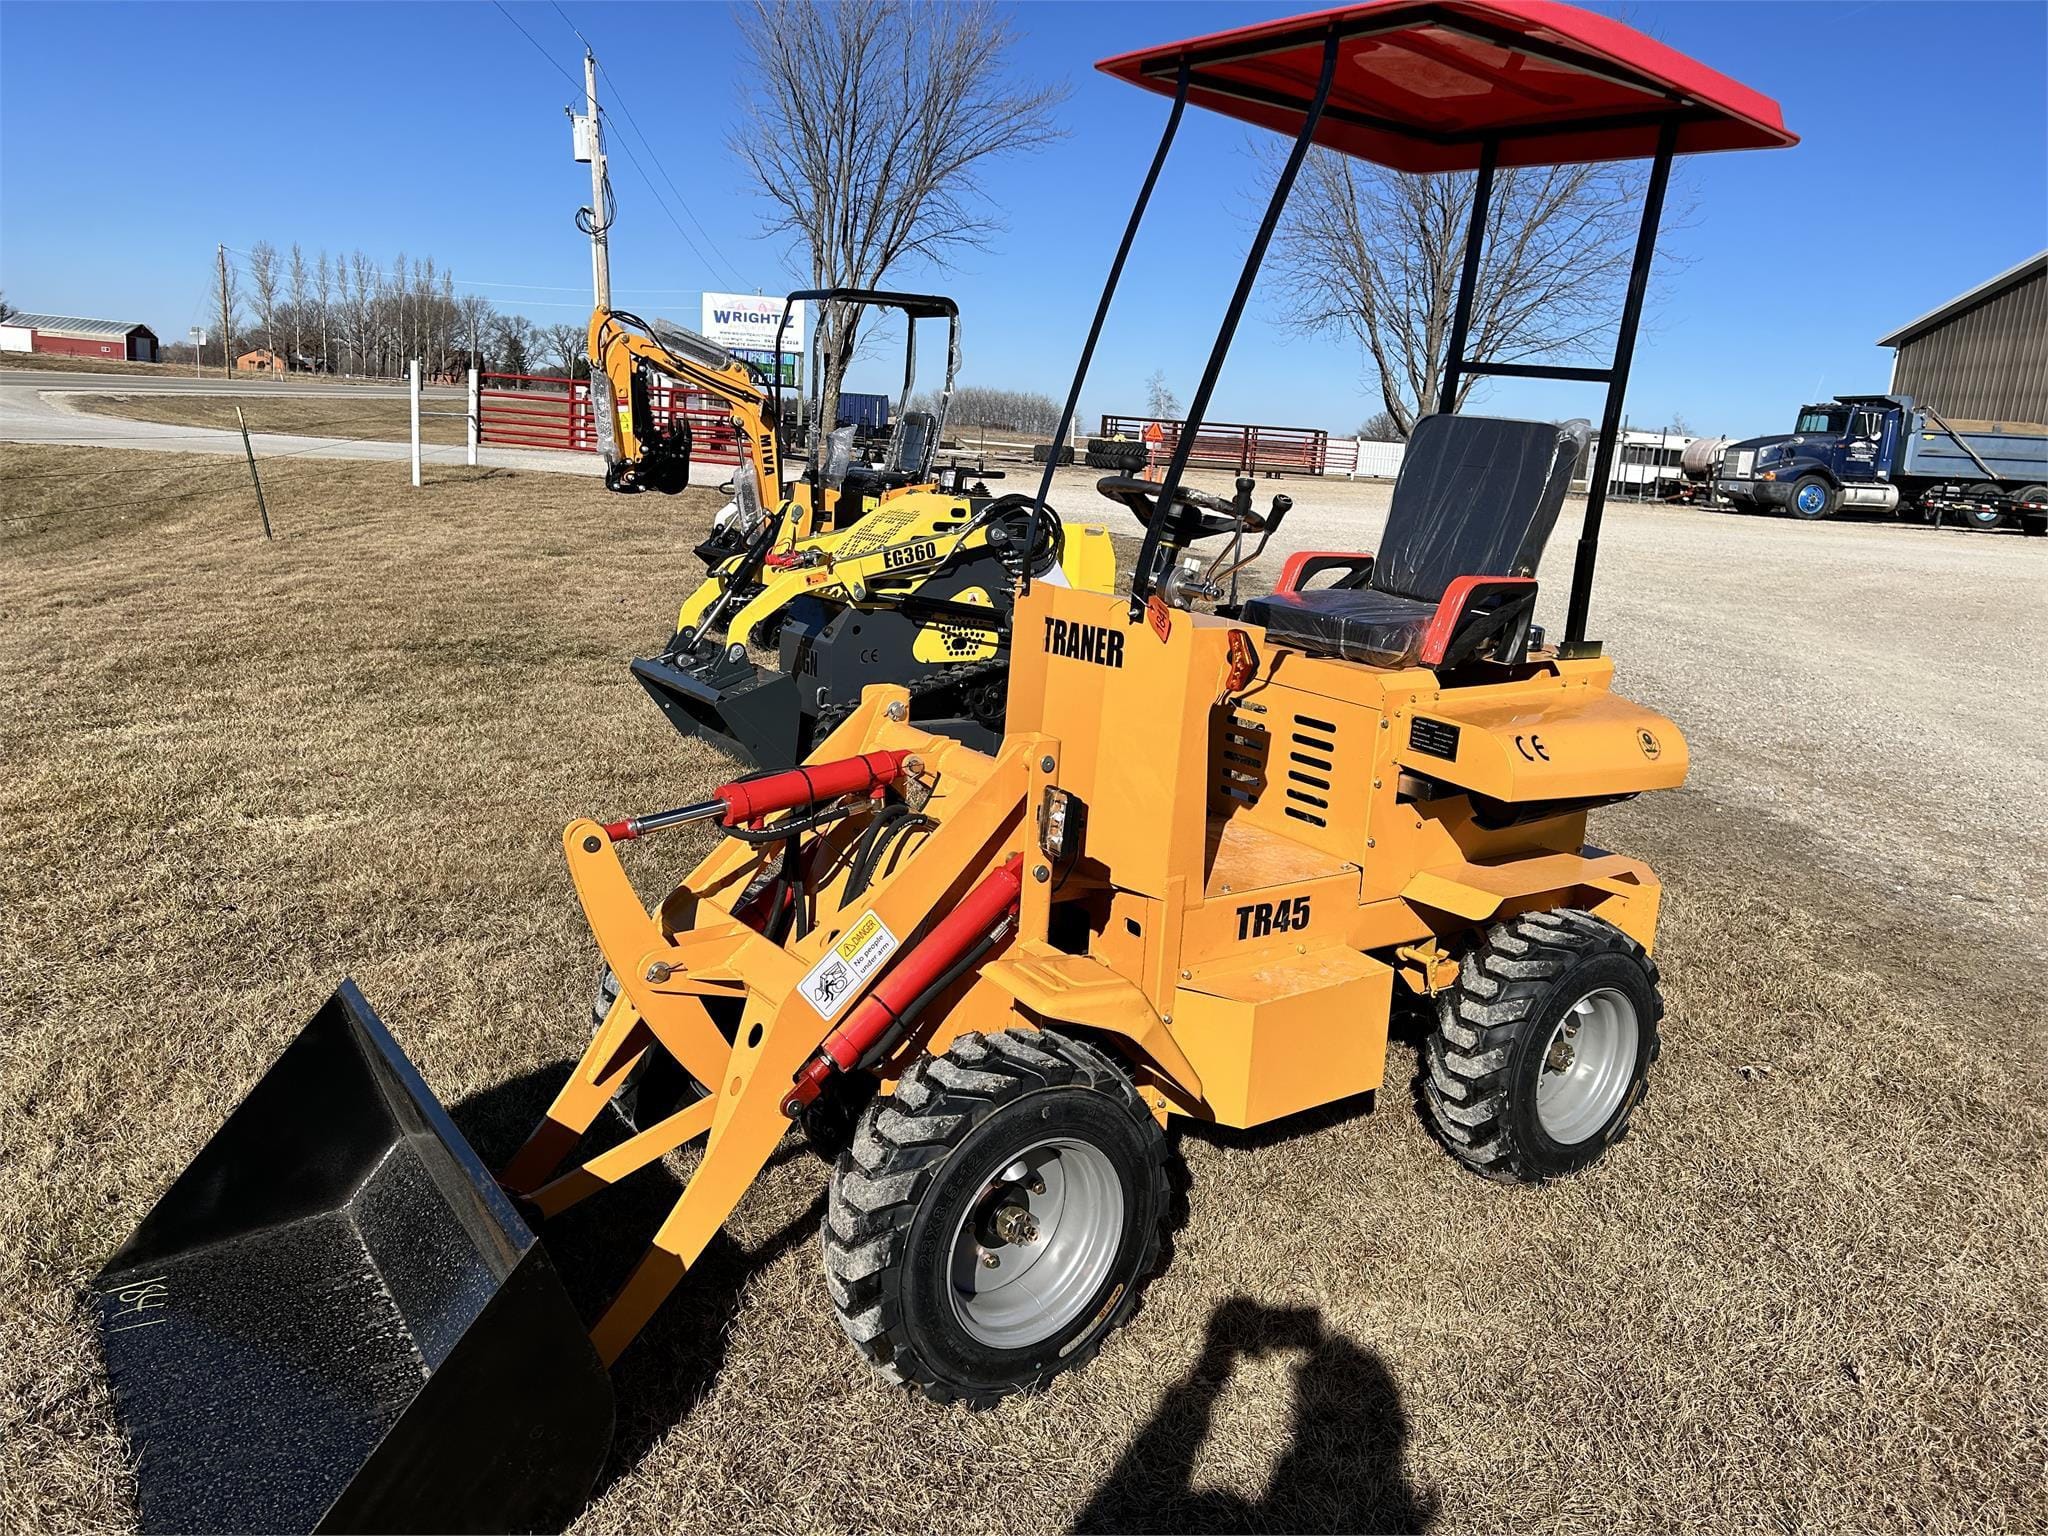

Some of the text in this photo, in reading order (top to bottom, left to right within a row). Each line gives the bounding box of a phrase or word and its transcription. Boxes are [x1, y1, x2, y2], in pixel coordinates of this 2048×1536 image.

[713, 309, 795, 328] WRIGHTZ
[760, 434, 775, 476] MIVA
[883, 541, 936, 568] EG360
[1044, 616, 1125, 669] TRANER
[851, 919, 876, 946] DANGER
[1236, 896, 1311, 941] TR45
[853, 934, 885, 967] No people
[860, 942, 890, 974] under arm
